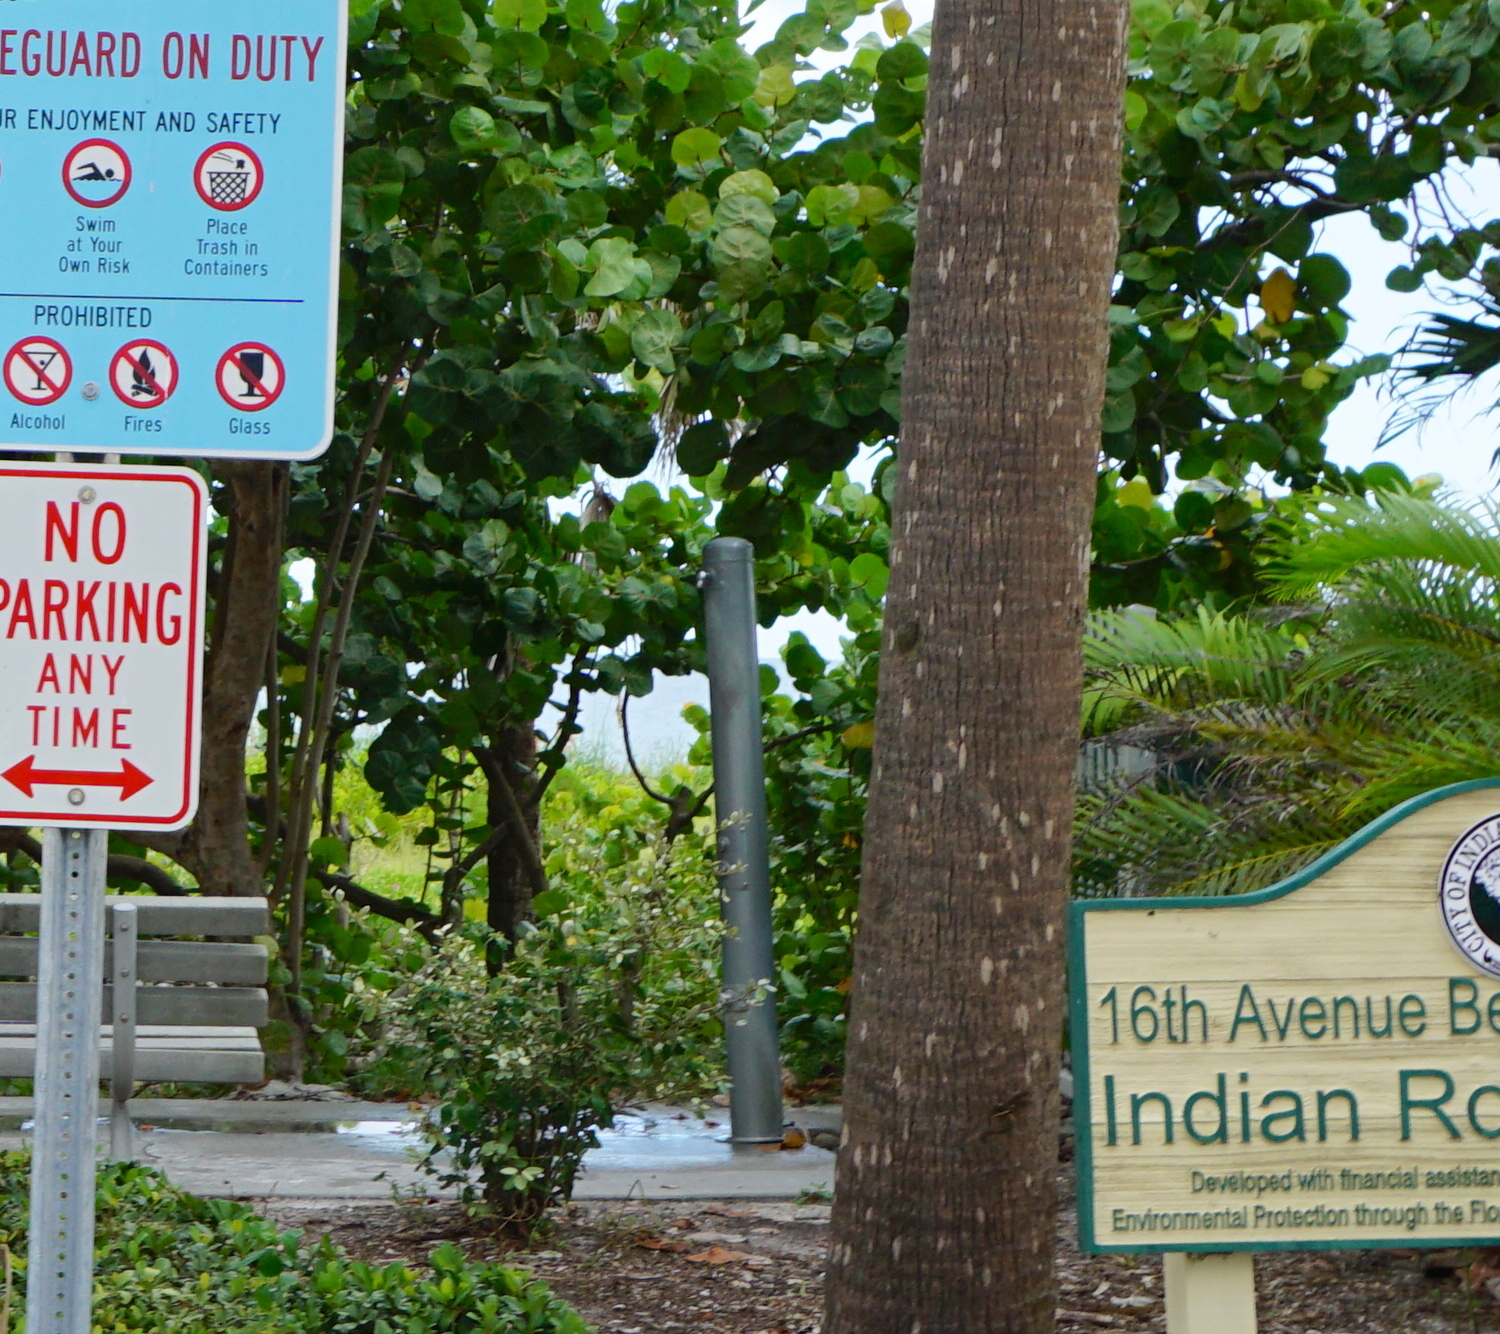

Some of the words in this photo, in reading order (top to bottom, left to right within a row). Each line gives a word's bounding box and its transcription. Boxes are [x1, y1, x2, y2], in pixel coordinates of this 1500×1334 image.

[162, 31, 209, 79] ON
[230, 34, 325, 82] DUTY
[27, 109, 147, 132] ENJOYMENT
[156, 111, 196, 133] AND
[205, 112, 282, 135] SAFETY
[75, 216, 116, 233] Swim
[206, 218, 248, 236] Place
[67, 237, 85, 253] at
[89, 236, 123, 254] Your
[196, 239, 238, 256] Trash
[242, 239, 259, 257] in
[58, 257, 91, 274] Own
[97, 257, 131, 275] Risk
[183, 259, 269, 277] Containers
[34, 305, 152, 329] PROHIBITED
[10, 413, 66, 431] Alcohol
[124, 416, 162, 433] Fires
[228, 418, 271, 436] Glass
[44, 500, 127, 565] NO
[36, 653, 126, 696] ANY
[26, 705, 133, 750] TIME
[1447, 872, 1467, 900] OF
[1449, 907, 1484, 954] CITY
[1098, 983, 1208, 1045] 16th
[1229, 982, 1427, 1043] Avenue
[1103, 1071, 1360, 1148] Indian
[1191, 1169, 1293, 1198] Developed
[1299, 1169, 1334, 1191] with
[1340, 1166, 1418, 1191] financial
[1112, 1206, 1247, 1232] Environmental
[1253, 1203, 1349, 1229] Protection
[1354, 1202, 1428, 1230] through
[1433, 1202, 1463, 1224] the
